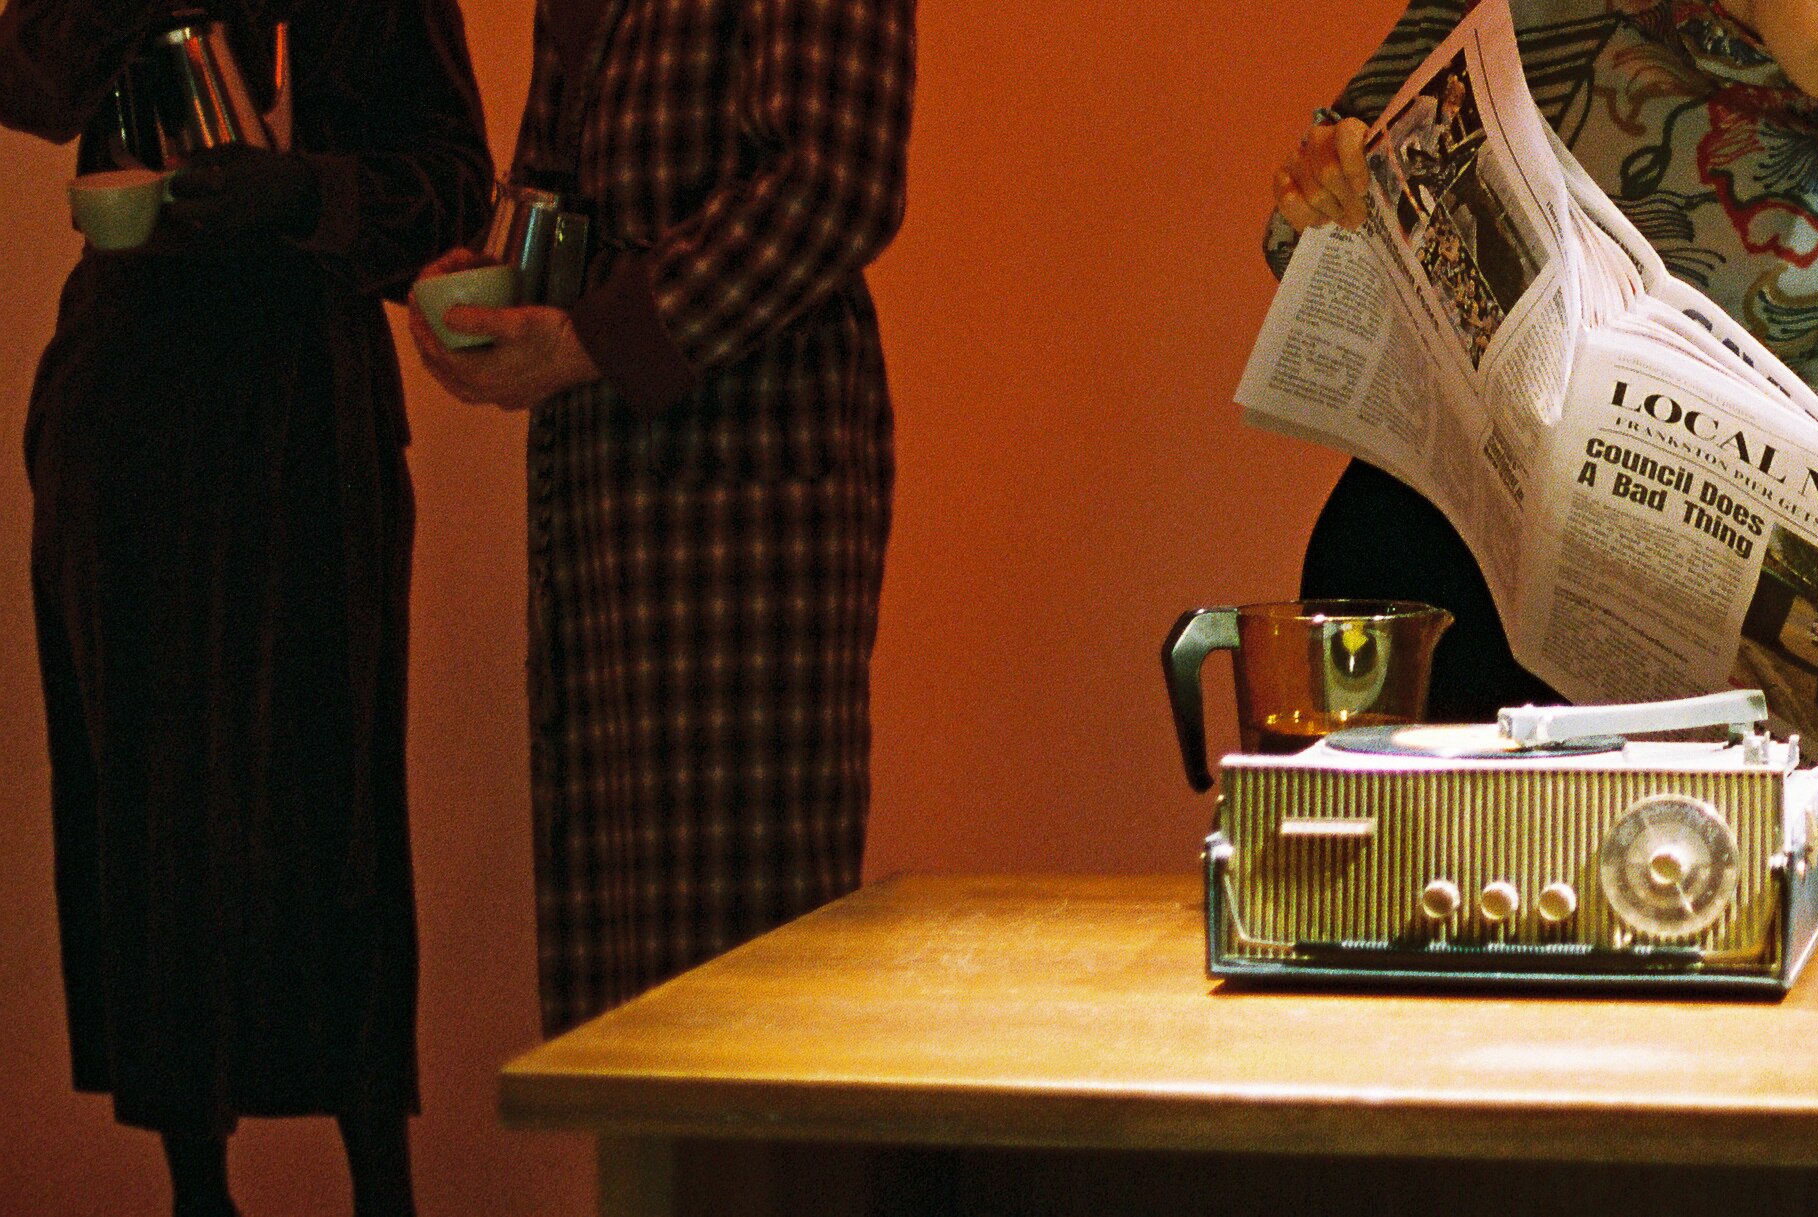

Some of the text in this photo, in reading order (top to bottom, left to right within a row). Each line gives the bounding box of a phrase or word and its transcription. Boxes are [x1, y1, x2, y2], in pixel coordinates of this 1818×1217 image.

[1611, 381, 1787, 484] LOCAL
[1615, 416, 1730, 471] FRANKSTON
[1734, 469, 1773, 501] PIER
[1577, 460, 1754, 560] A Bad Thing
[1700, 480, 1765, 536] Does
